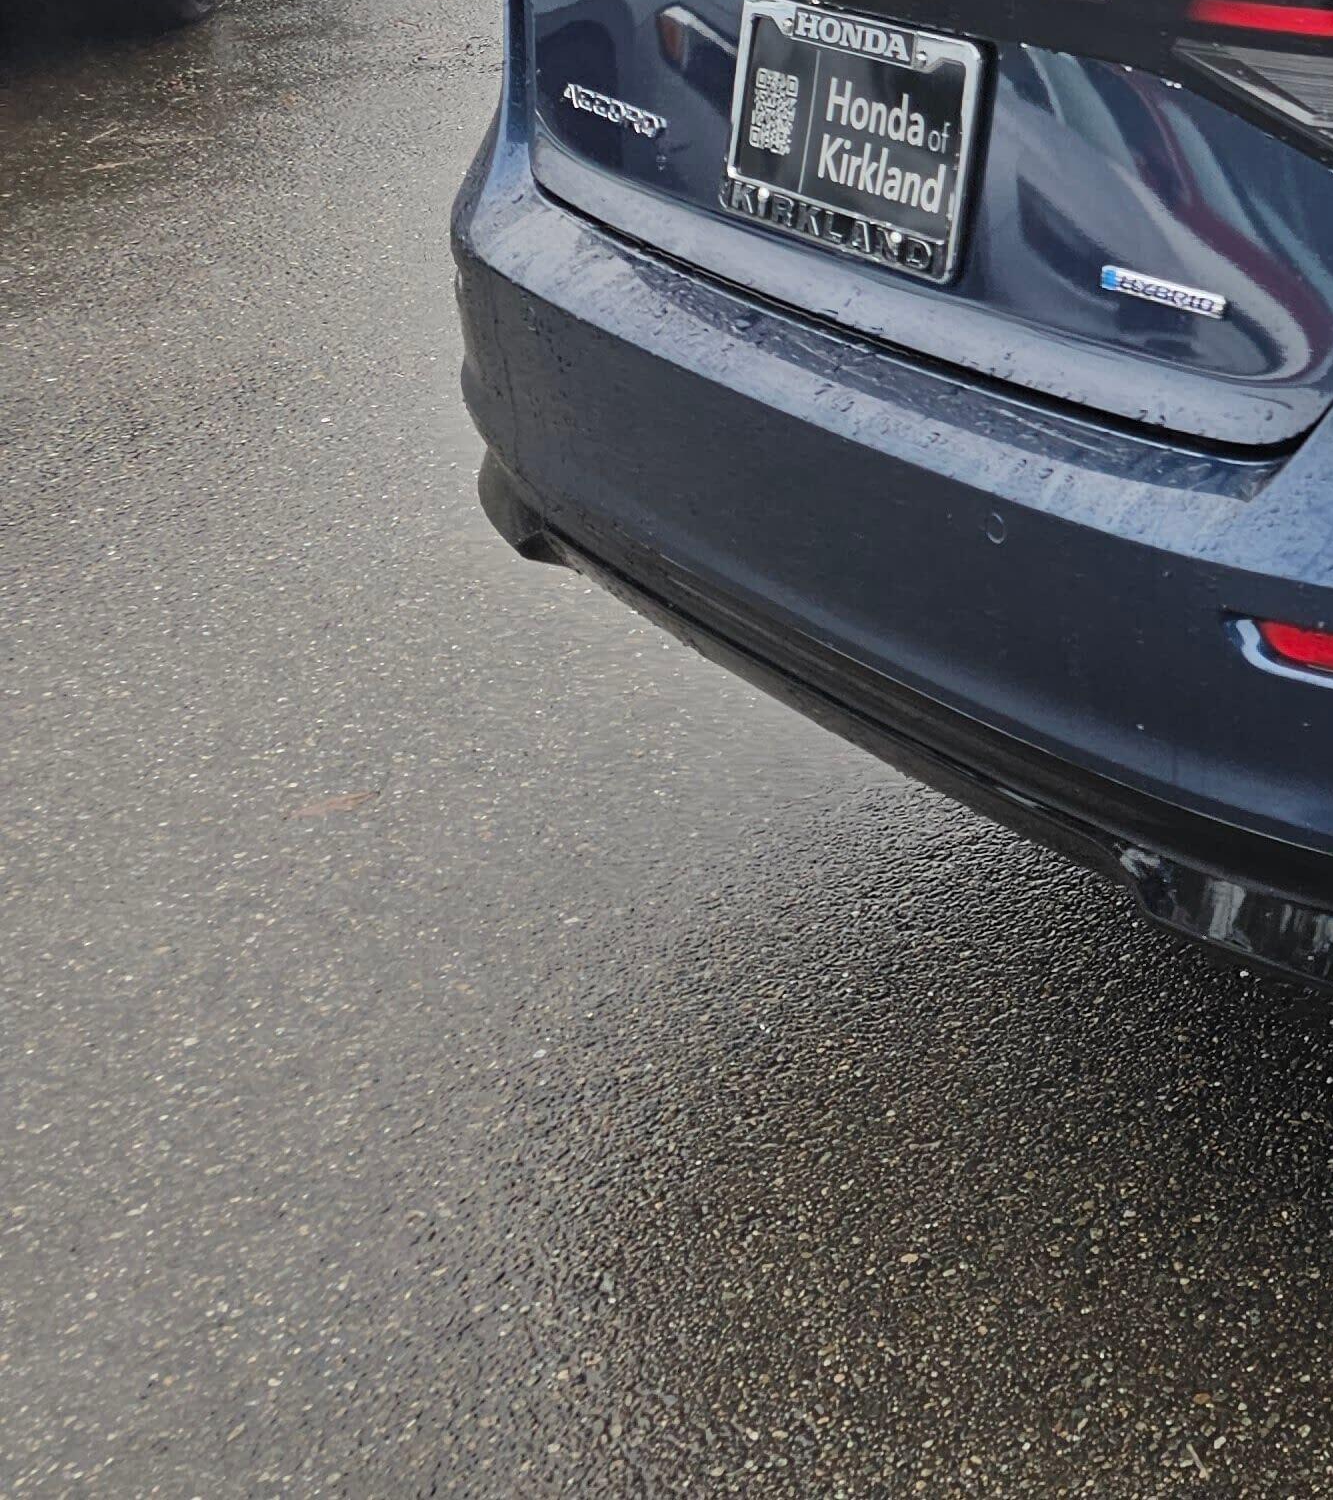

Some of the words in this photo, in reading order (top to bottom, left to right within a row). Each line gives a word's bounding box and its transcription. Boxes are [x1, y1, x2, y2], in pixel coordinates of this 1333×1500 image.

[794, 11, 911, 62] HONDA
[825, 76, 926, 147] Honda
[927, 121, 951, 154] of
[817, 133, 947, 214] Kirkland
[731, 180, 933, 269] KIRKLAND
